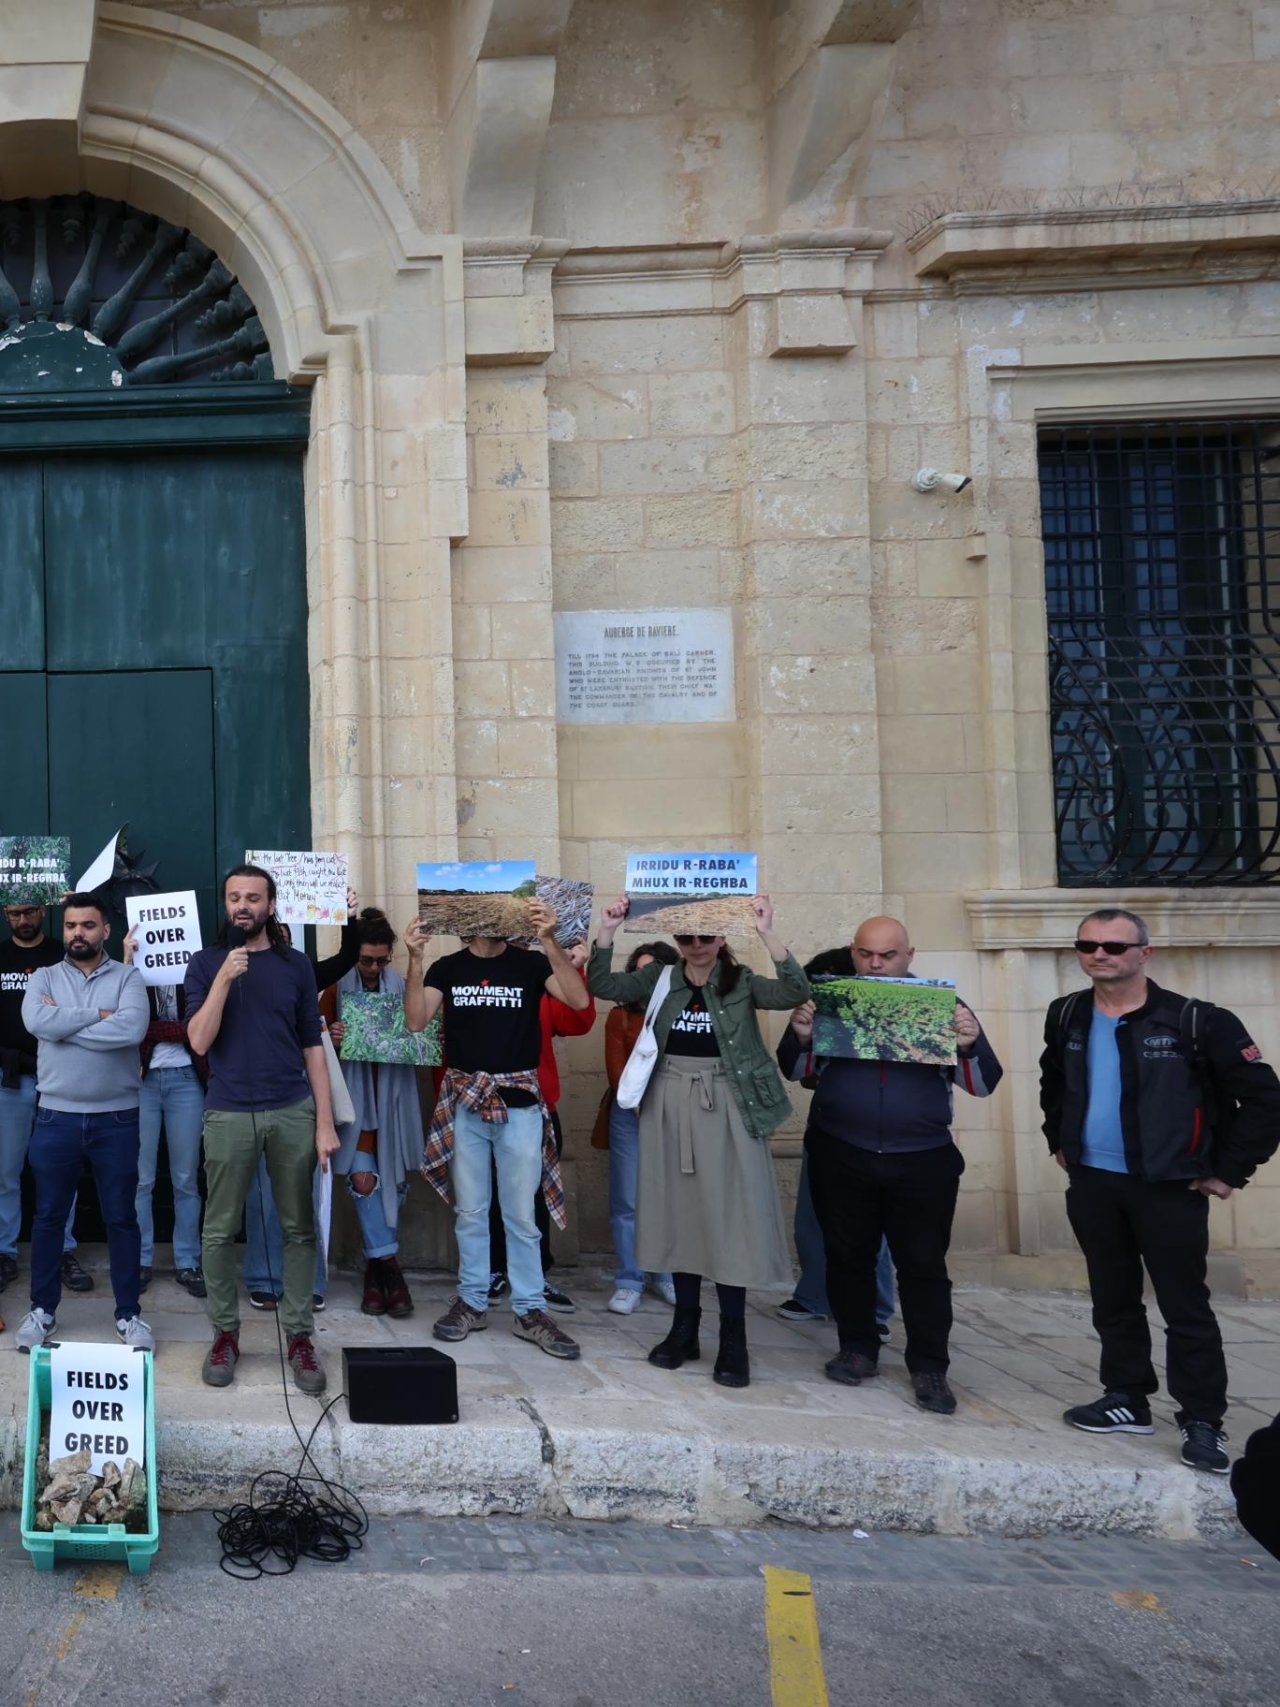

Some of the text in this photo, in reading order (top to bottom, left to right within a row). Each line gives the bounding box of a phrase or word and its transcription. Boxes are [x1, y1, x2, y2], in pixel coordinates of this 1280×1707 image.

[636, 859, 741, 871] IRRIDU R-RABA'
[632, 877, 670, 888] MHUX
[139, 905, 187, 923] FIELDS
[145, 927, 186, 945] OVER
[144, 950, 192, 969] GREED
[453, 996, 522, 1008] GRAFFITTI
[66, 1370, 129, 1391] FIELDS
[72, 1399, 124, 1422] OVER
[64, 1432, 129, 1456] GREED
